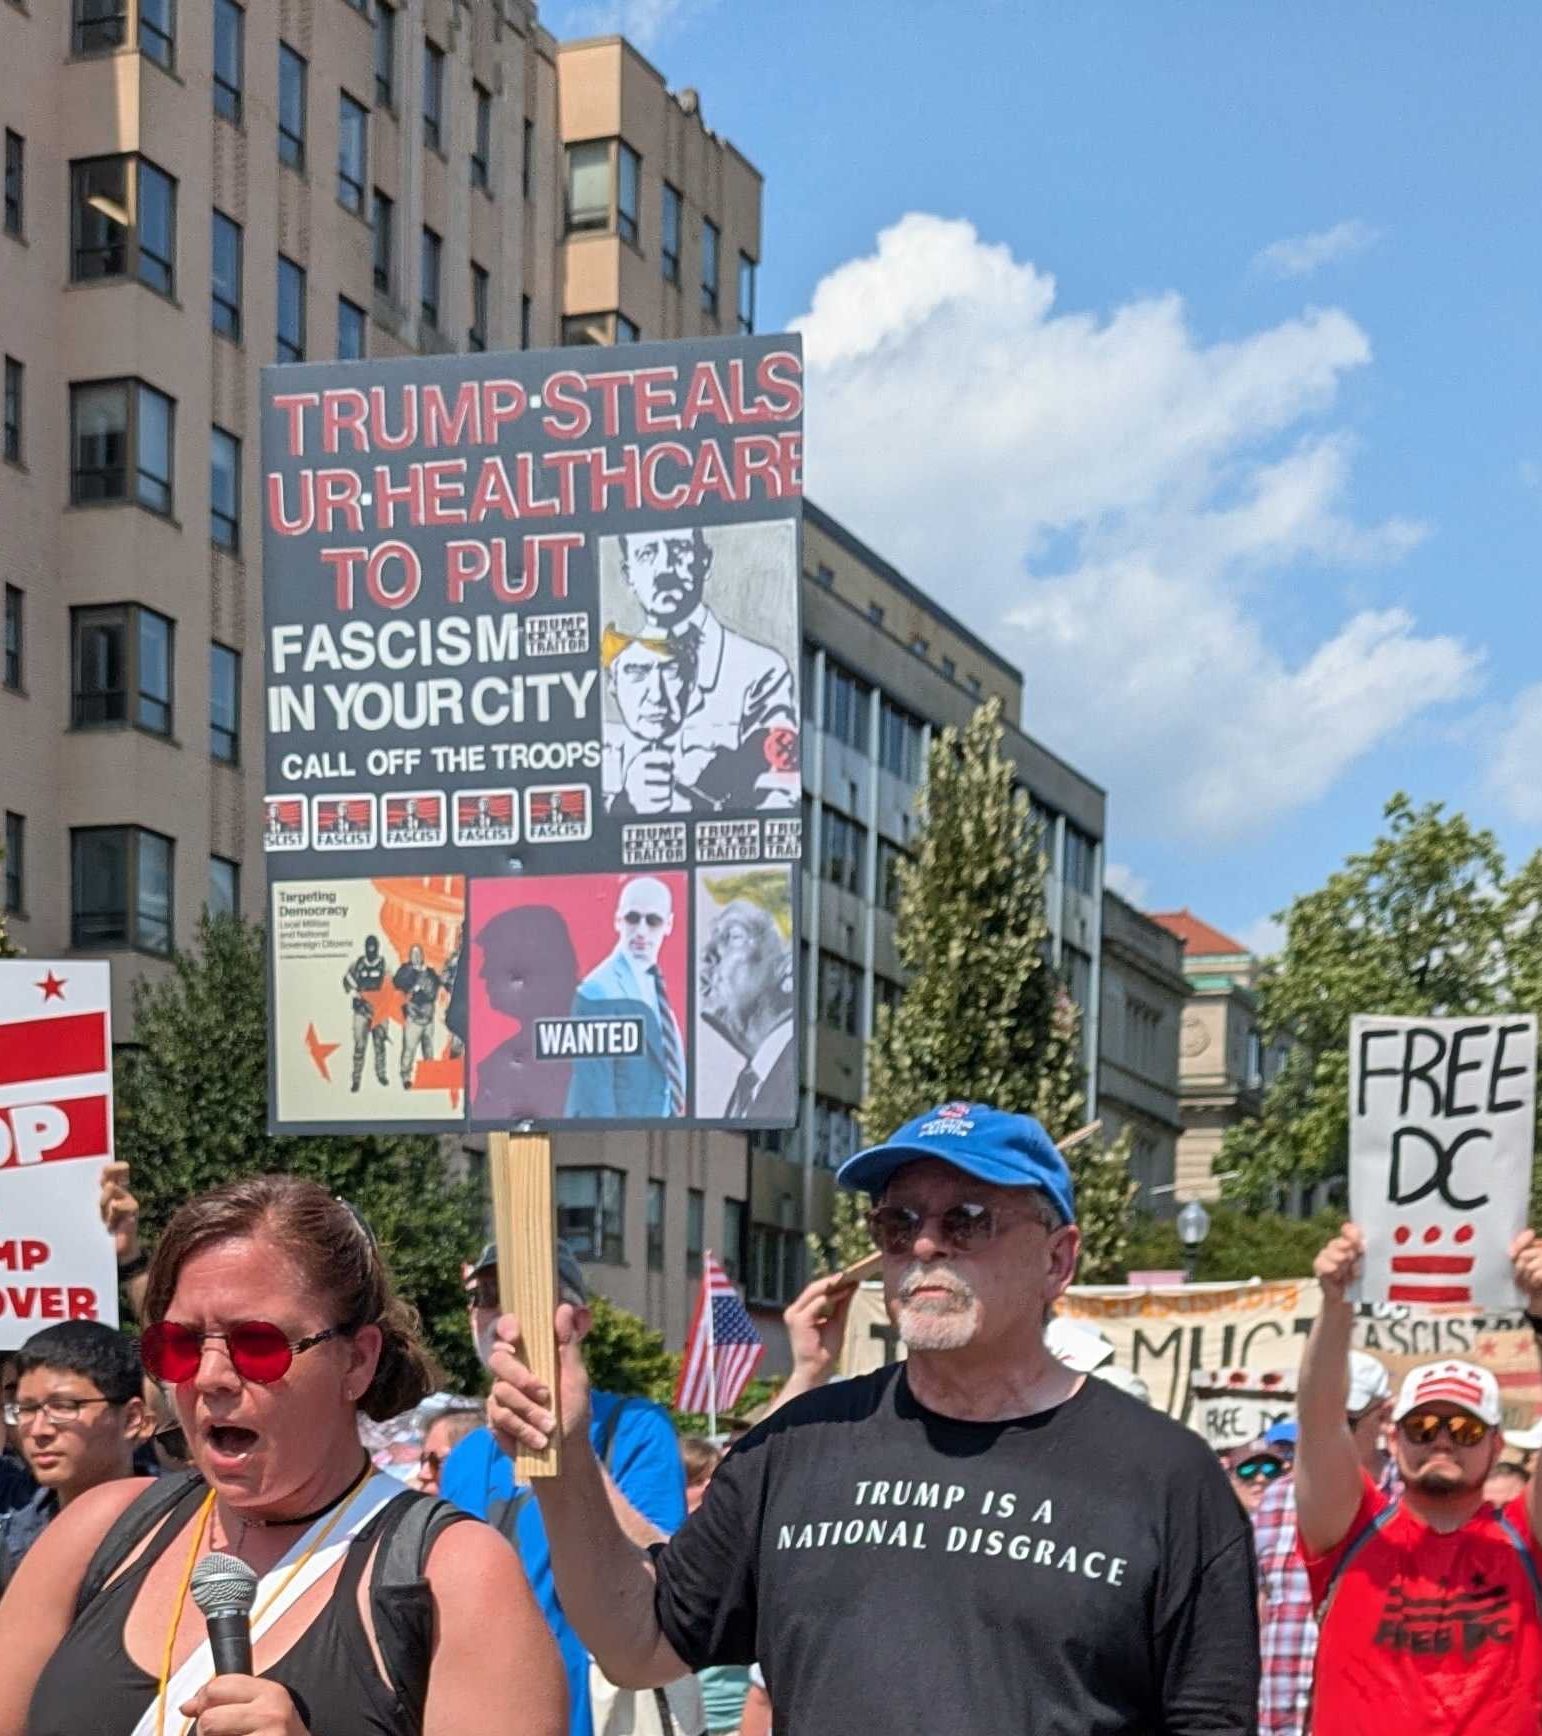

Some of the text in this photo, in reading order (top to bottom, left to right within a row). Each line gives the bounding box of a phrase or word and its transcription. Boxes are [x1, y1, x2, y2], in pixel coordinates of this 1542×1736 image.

[273, 351, 802, 456] TRUMP STEALS
[267, 431, 802, 536] UR HEALTHCARE
[321, 533, 586, 611] TO PUT
[271, 613, 520, 673] FASCISM
[268, 669, 598, 733] IN YOUR CITY
[281, 740, 601, 781] CALL OFF THE TROOPS
[266, 833, 303, 847] SCIST
[625, 827, 684, 841] TRUMP
[699, 823, 757, 838] TRUMP
[768, 823, 801, 837] TRU
[626, 849, 684, 863] TRAITOR
[699, 846, 757, 860] TRAITOR
[768, 844, 801, 860] TRAI
[279, 891, 336, 904] Targeting
[279, 905, 349, 918] Democracy
[540, 1021, 639, 1055] WANTED
[1358, 1024, 1530, 1117] FREE
[1387, 1126, 1493, 1210] DC
[854, 1480, 1053, 1524] TRUMP IS A
[776, 1519, 1128, 1586] NATIONAL DISGRACE
[1372, 1621, 1453, 1654] FREE
